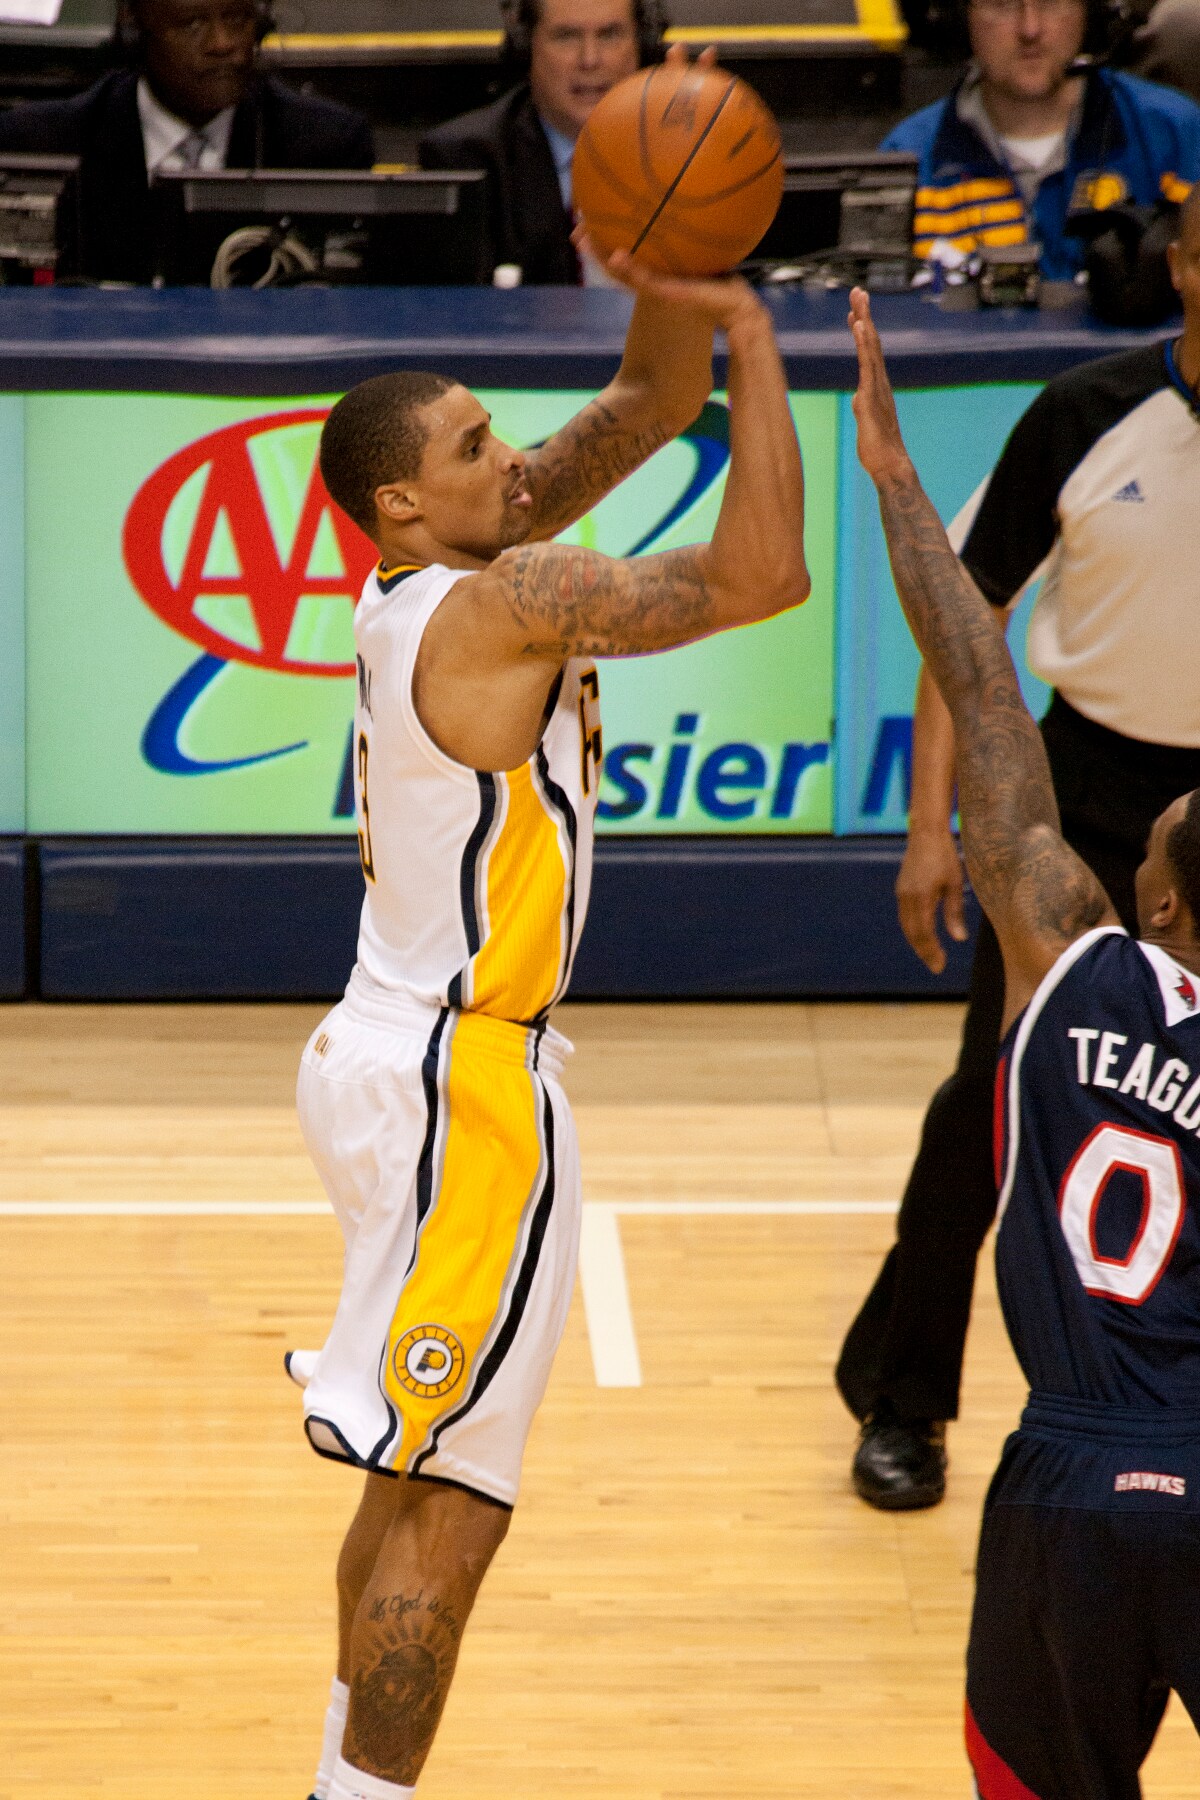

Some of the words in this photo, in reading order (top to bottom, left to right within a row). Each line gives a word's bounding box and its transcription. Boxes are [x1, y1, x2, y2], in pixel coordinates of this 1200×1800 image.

[136, 410, 386, 672] AA
[590, 712, 832, 821] sier
[1067, 1027, 1200, 1140] TEAGU
[1057, 1120, 1187, 1308] 0
[1113, 1471, 1186, 1496] HAWKS
